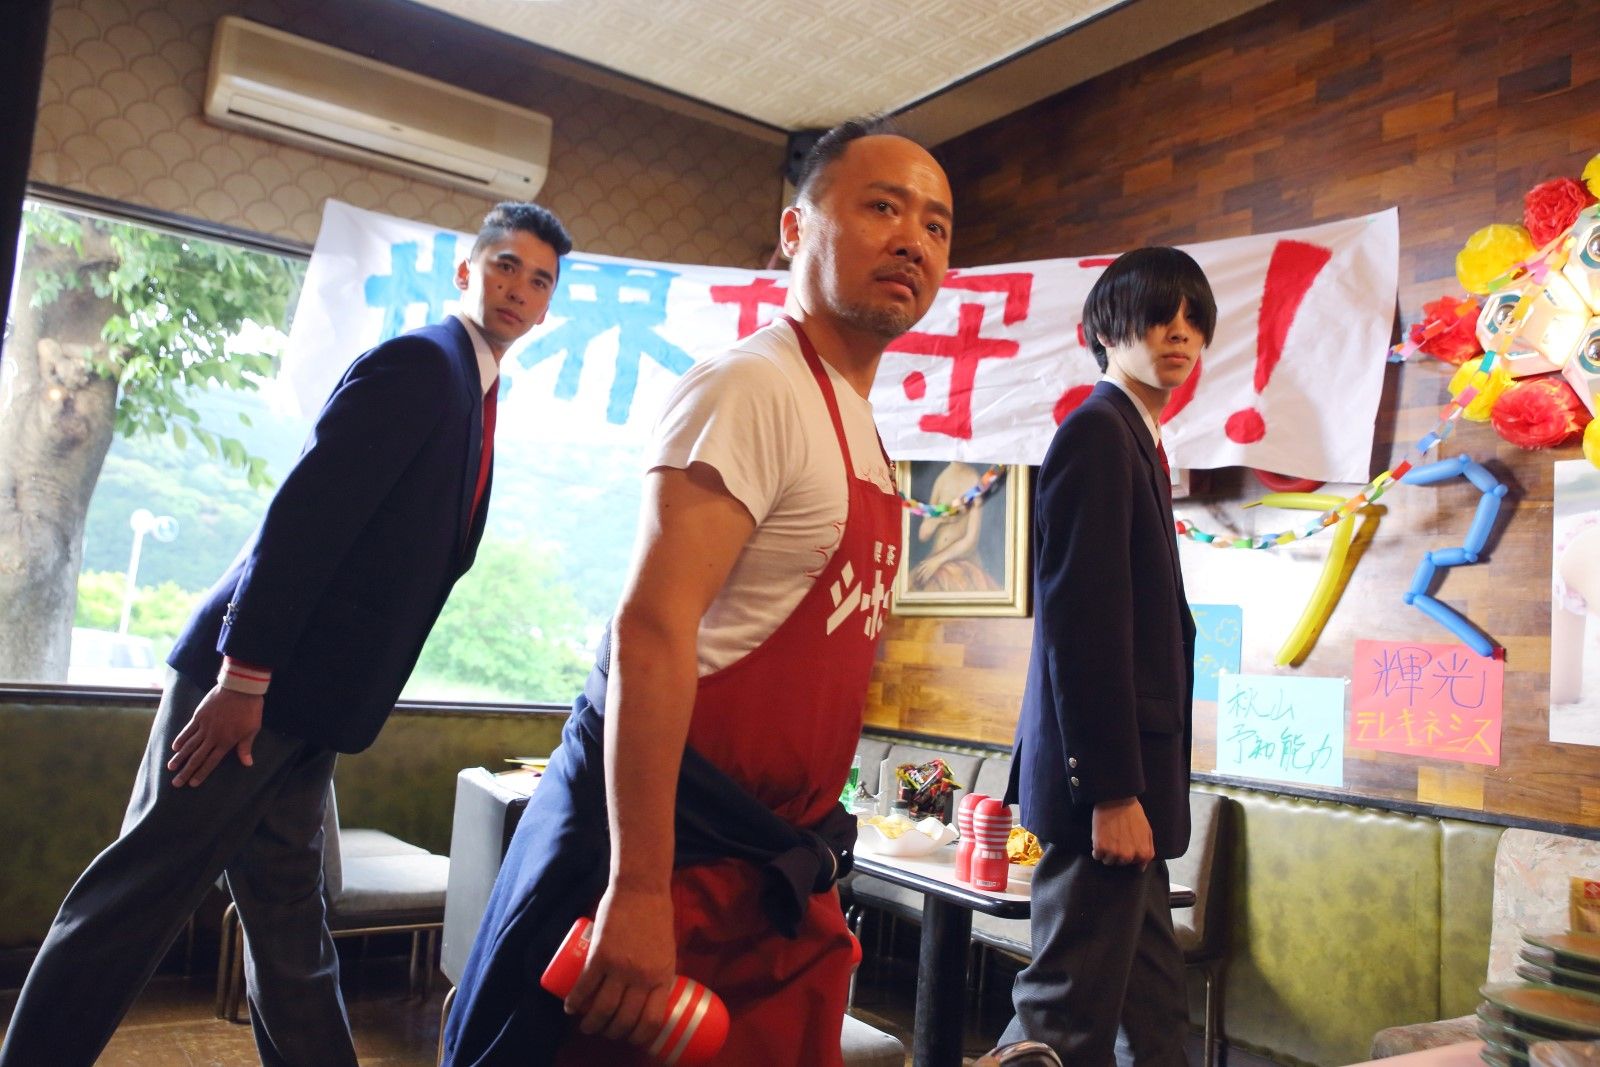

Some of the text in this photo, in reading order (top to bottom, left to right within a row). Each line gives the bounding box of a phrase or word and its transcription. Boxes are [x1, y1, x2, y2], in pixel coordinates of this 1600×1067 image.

[364, 232, 1332, 444] 界守!
[1372, 648, 1487, 709] 輝光
[1356, 709, 1494, 757] テレキネシス
